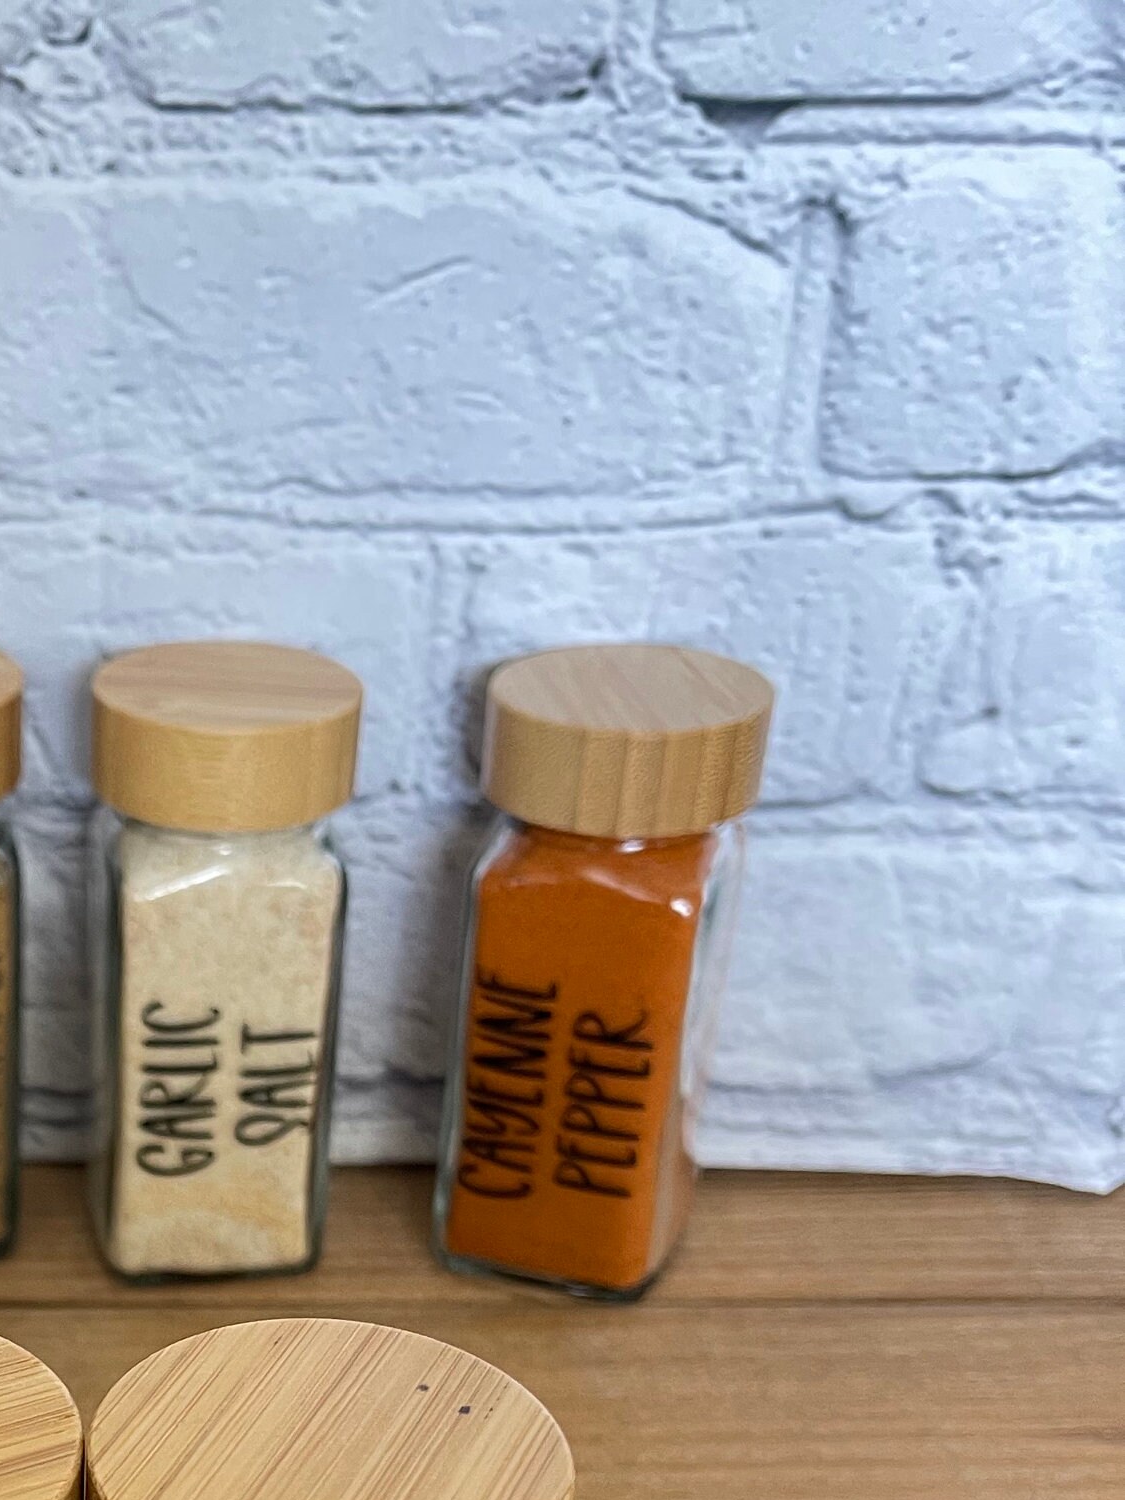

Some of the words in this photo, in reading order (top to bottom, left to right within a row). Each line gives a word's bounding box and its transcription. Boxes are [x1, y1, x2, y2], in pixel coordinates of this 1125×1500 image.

[137, 1002, 220, 1176] GARLIC
[234, 1022, 317, 1147] SALT
[458, 964, 558, 1198] CAYENNE
[552, 1009, 653, 1198] PEPPER
